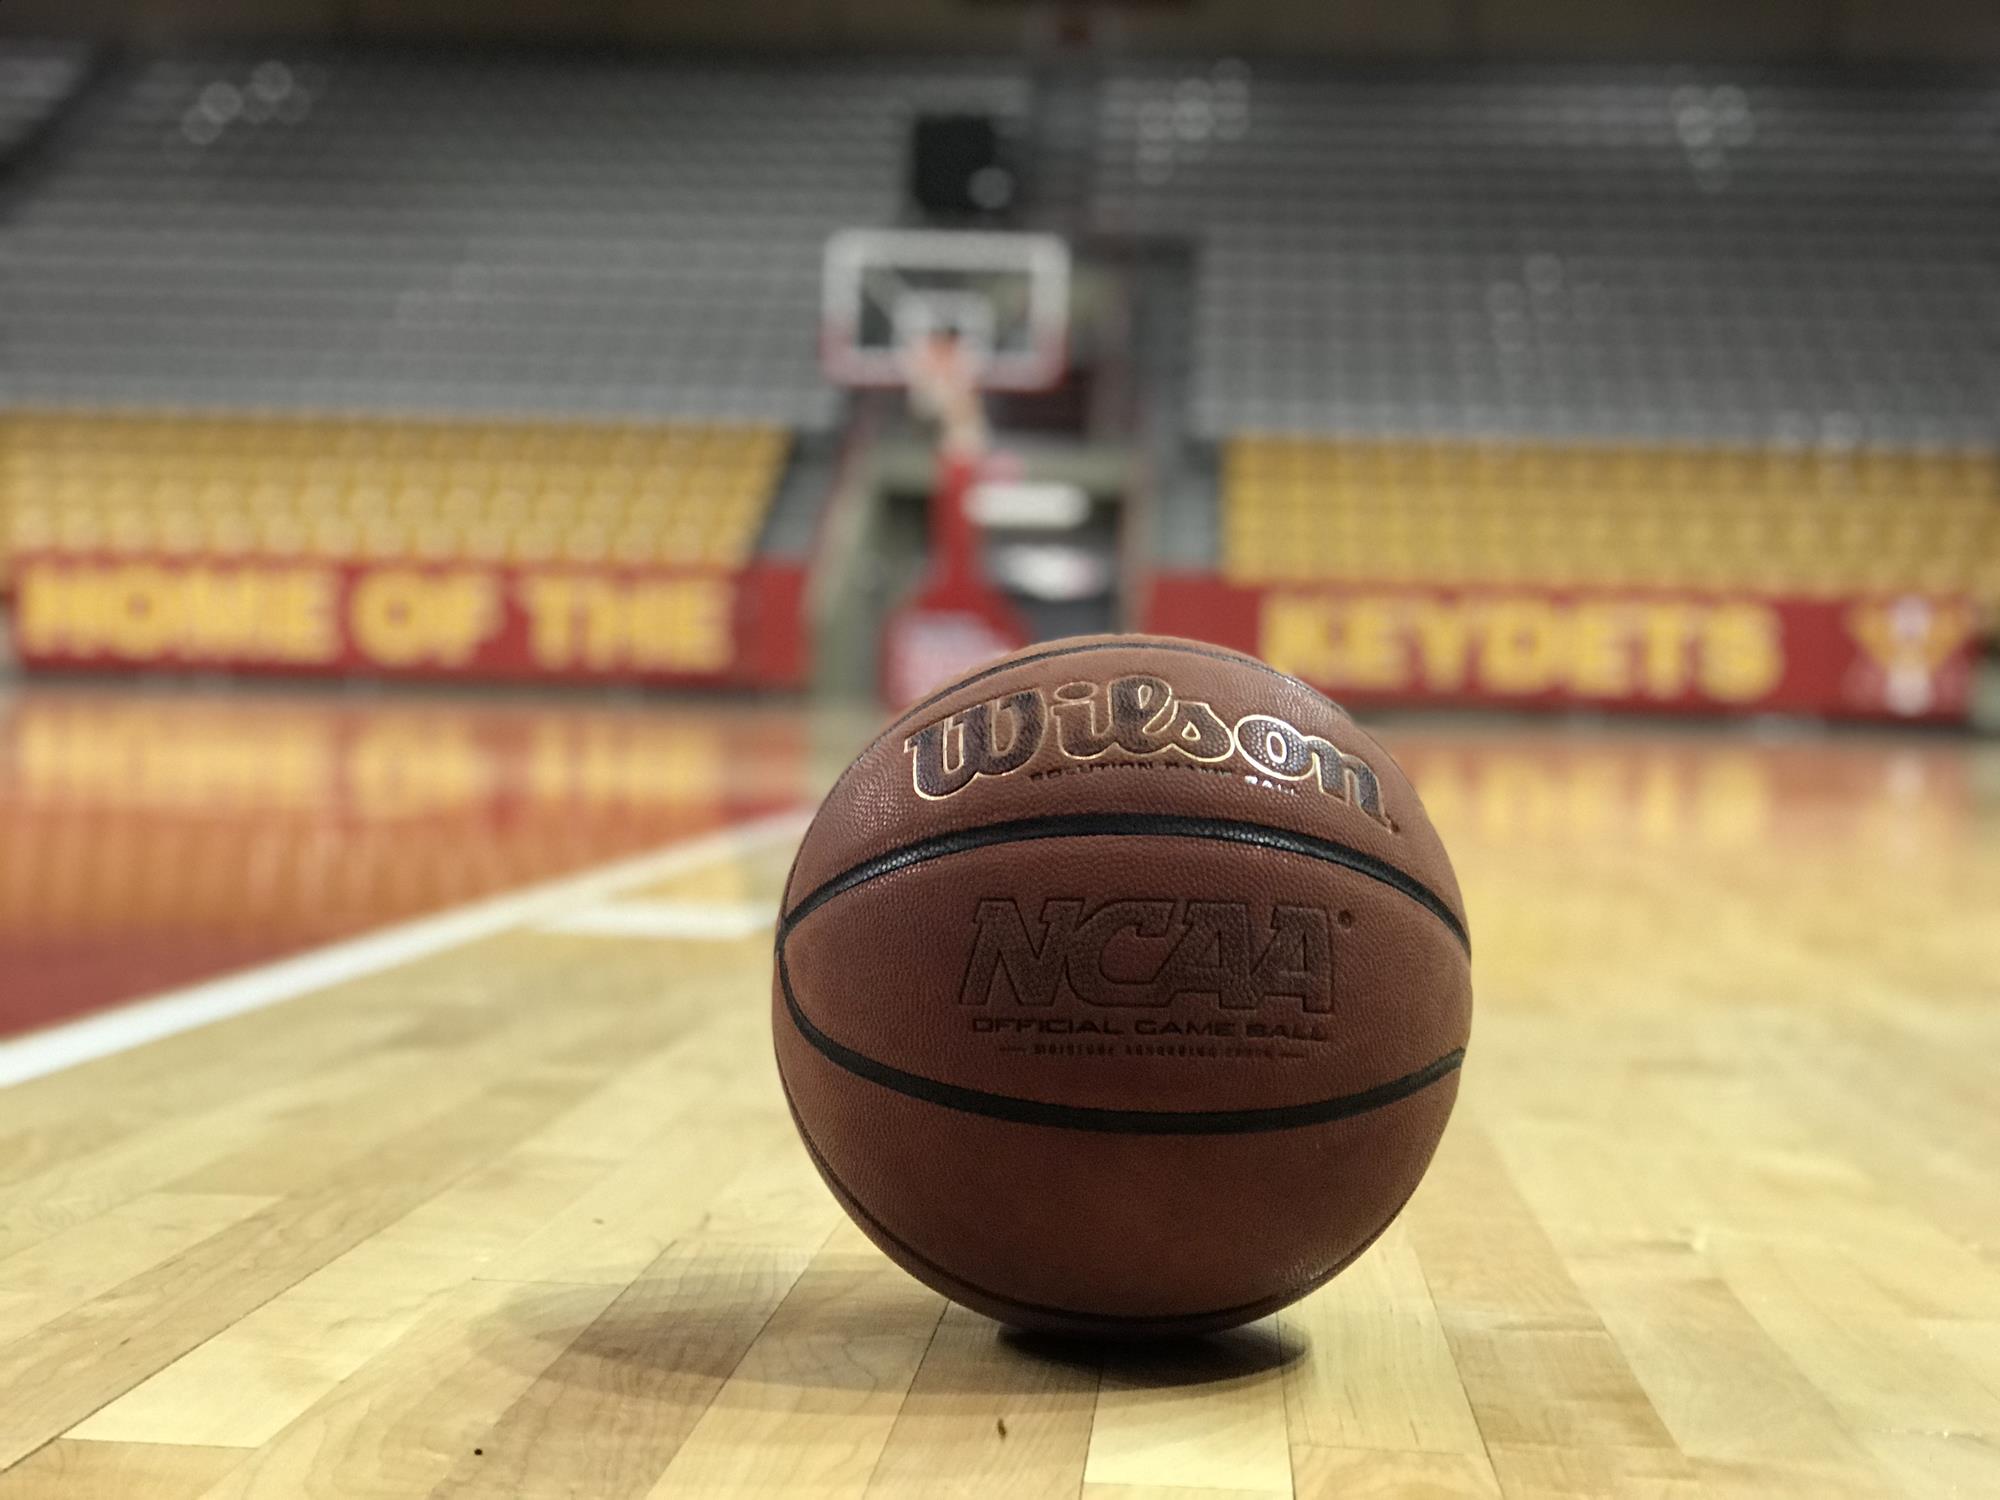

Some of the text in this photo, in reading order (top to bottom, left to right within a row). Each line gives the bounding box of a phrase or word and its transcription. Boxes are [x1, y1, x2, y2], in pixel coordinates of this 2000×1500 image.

[22, 565, 735, 672] HOME OF THE
[1260, 596, 1783, 703] KEYDETS
[904, 674, 1394, 834] Wilson
[959, 897, 1336, 1014] NCAA
[972, 1018, 1331, 1042] OFFICIAL GAME BALL
